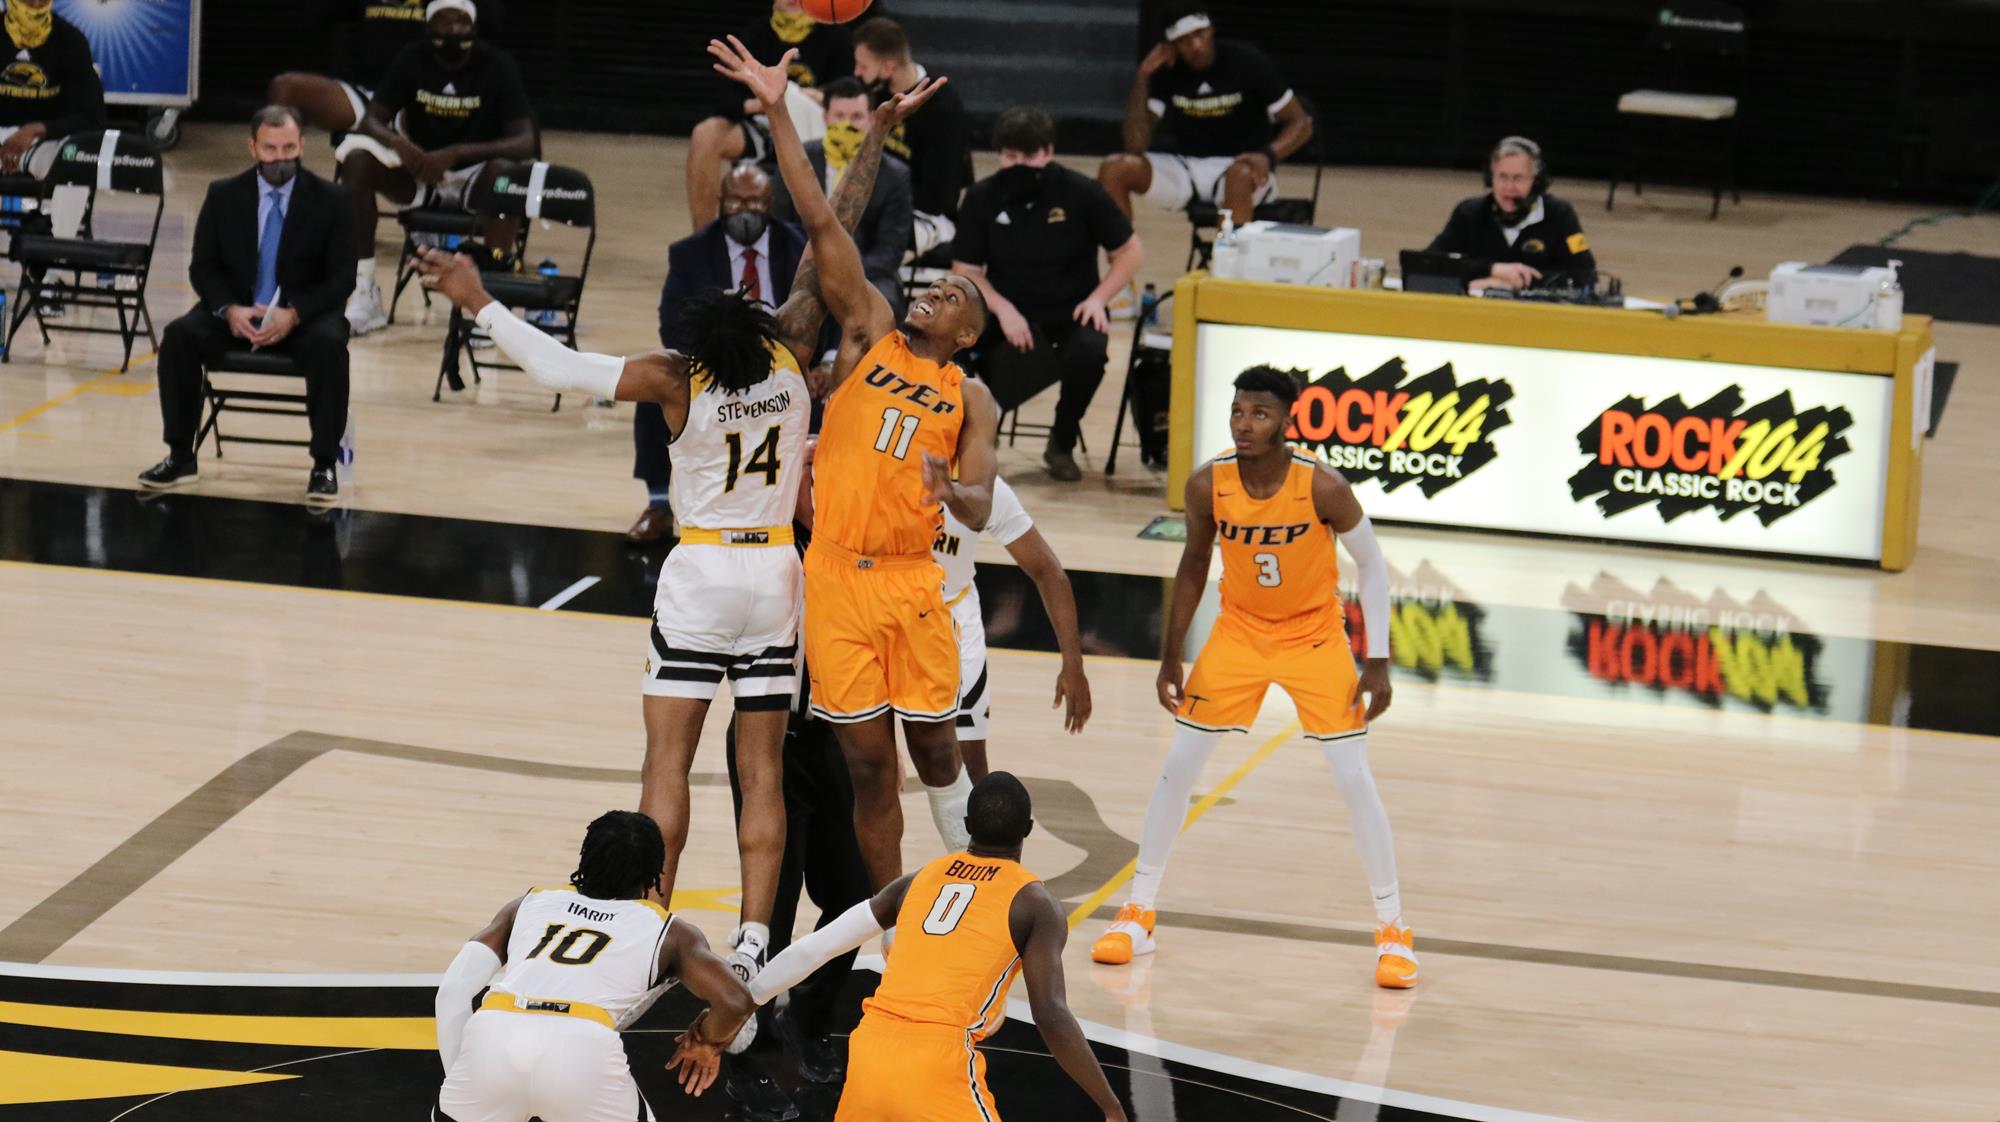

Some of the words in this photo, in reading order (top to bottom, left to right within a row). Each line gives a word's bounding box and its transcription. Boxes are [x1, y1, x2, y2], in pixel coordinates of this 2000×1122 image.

[76, 150, 155, 168] BanpSouth
[717, 390, 790, 422] STEVENSON
[1381, 391, 1491, 455] 104
[873, 406, 920, 461] 11
[1600, 410, 1748, 476] ROCK
[1717, 418, 1830, 483] 104
[724, 424, 781, 494] 14
[1285, 441, 1384, 471] ASSIC
[1390, 451, 1464, 478] ROCK
[1613, 468, 1720, 500] CLASSIC
[1725, 478, 1802, 506] ROCK
[1220, 520, 1310, 545] UTEP
[1254, 553, 1281, 588] 3
[945, 859, 1001, 881] BOUM
[567, 902, 618, 923] HARDY
[922, 883, 977, 936] 0
[525, 921, 613, 966] 10
